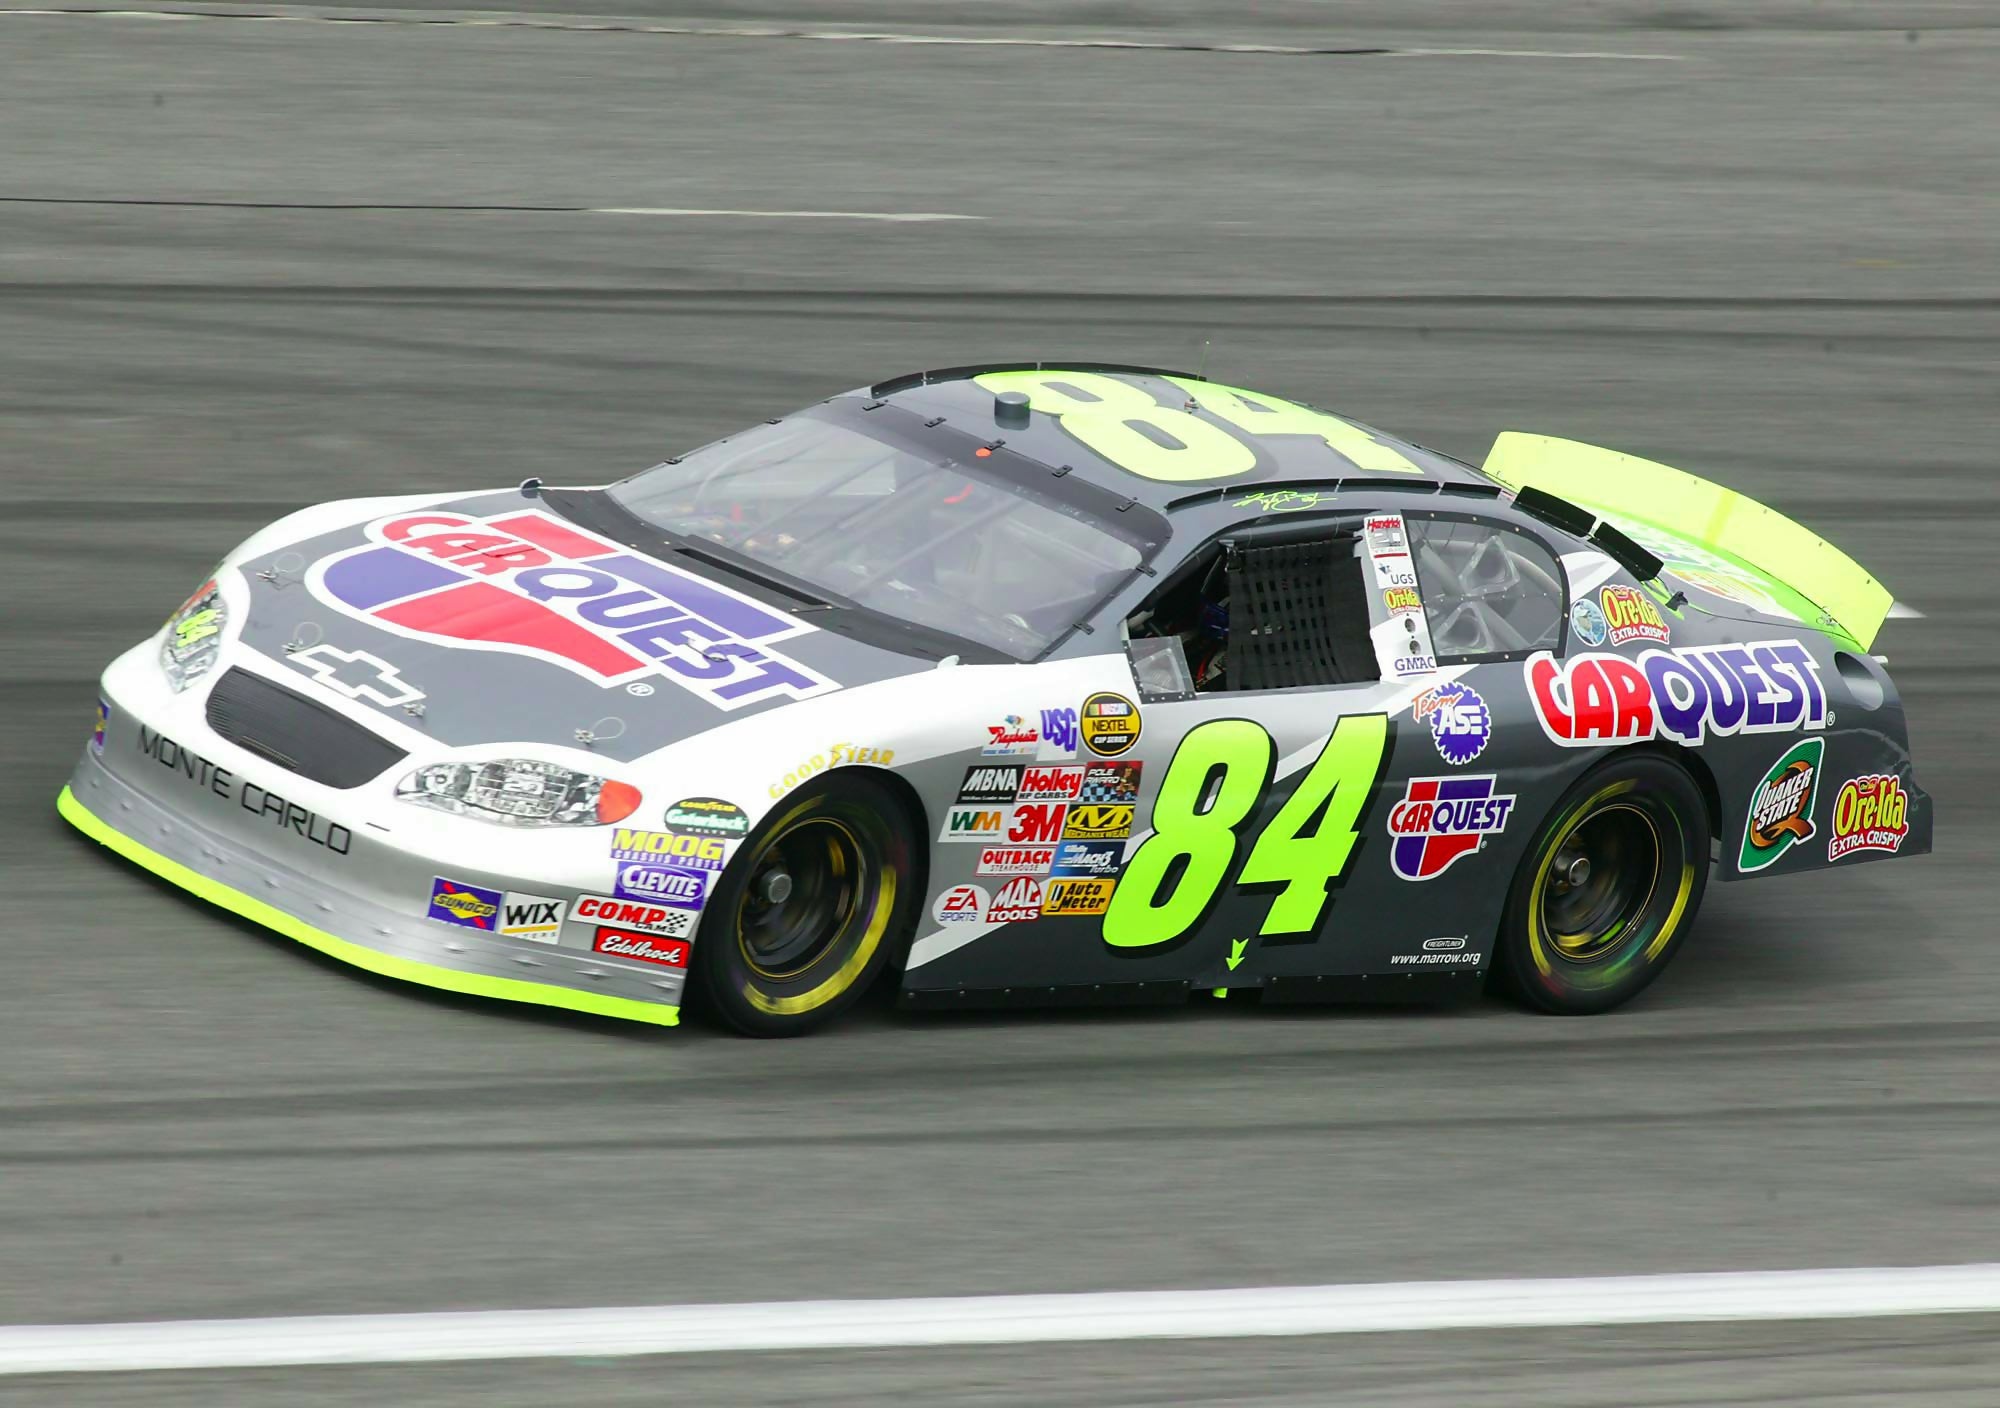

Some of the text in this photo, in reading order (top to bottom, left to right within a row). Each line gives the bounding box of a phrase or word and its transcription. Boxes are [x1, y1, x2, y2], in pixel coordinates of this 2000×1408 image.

[973, 370, 1424, 482] 84
[1391, 574, 1414, 584] UGS
[381, 515, 818, 701] CARQUEST
[1612, 625, 1669, 642] EXTRA CRISPY
[1394, 656, 1436, 671] GMAC
[1411, 688, 1464, 722] Team
[1531, 645, 1823, 740] CARQUEST
[1040, 708, 1078, 752] USG
[1092, 720, 1131, 732] NEXTEL
[1436, 705, 1483, 735] ASE
[962, 769, 1017, 792] MBNA
[1021, 768, 1083, 798] Holley
[1088, 768, 1115, 776] POLE
[140, 724, 351, 855] MONTE CARLO
[1753, 767, 1814, 819] QUAKER
[1391, 799, 1513, 834] CARQUEST
[1756, 791, 1803, 831] STATE
[1836, 780, 1904, 836] Ore-Ida
[1008, 804, 1067, 843] 3M
[1101, 712, 1389, 948] 84
[612, 829, 725, 860] MOOG
[1831, 830, 1901, 857] EXTRA CRISPY
[614, 850, 721, 870] CHASSIS PARTS
[983, 850, 1052, 865] OUTBACK
[1088, 865, 1120, 874] Turbo
[943, 888, 978, 911] EA
[991, 878, 1042, 909] MAC
[1062, 894, 1106, 909] Meter
[1065, 884, 1102, 894] Auto
[438, 894, 494, 915] SUNOCO
[506, 902, 562, 926] WIX
[578, 899, 667, 924] COMP
[938, 912, 978, 922] SPORTS
[988, 908, 1039, 922] TOOLS
[634, 922, 678, 934] CAMS
[600, 935, 682, 964] Edelbrock
[1390, 953, 1481, 965] www.marrow.org
